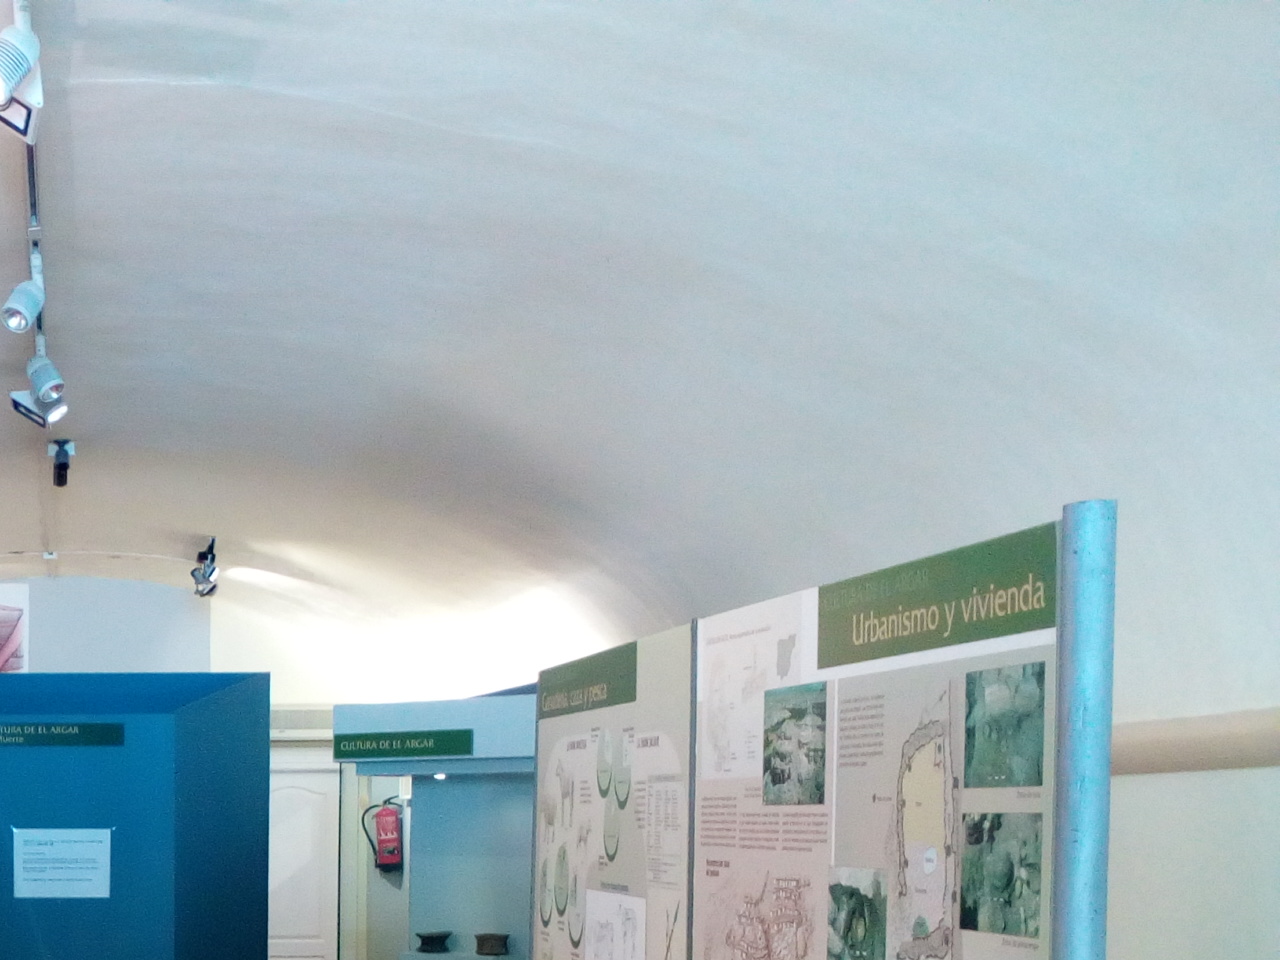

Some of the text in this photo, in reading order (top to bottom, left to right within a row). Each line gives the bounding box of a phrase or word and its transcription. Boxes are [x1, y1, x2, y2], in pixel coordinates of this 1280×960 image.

[851, 572, 1047, 646] Urbanismo y vivienda
[24, 725, 36, 735] DE
[38, 725, 47, 735] EL
[50, 725, 80, 735] ARGAR
[340, 738, 435, 751] CULTURA DE EL ARGAR
